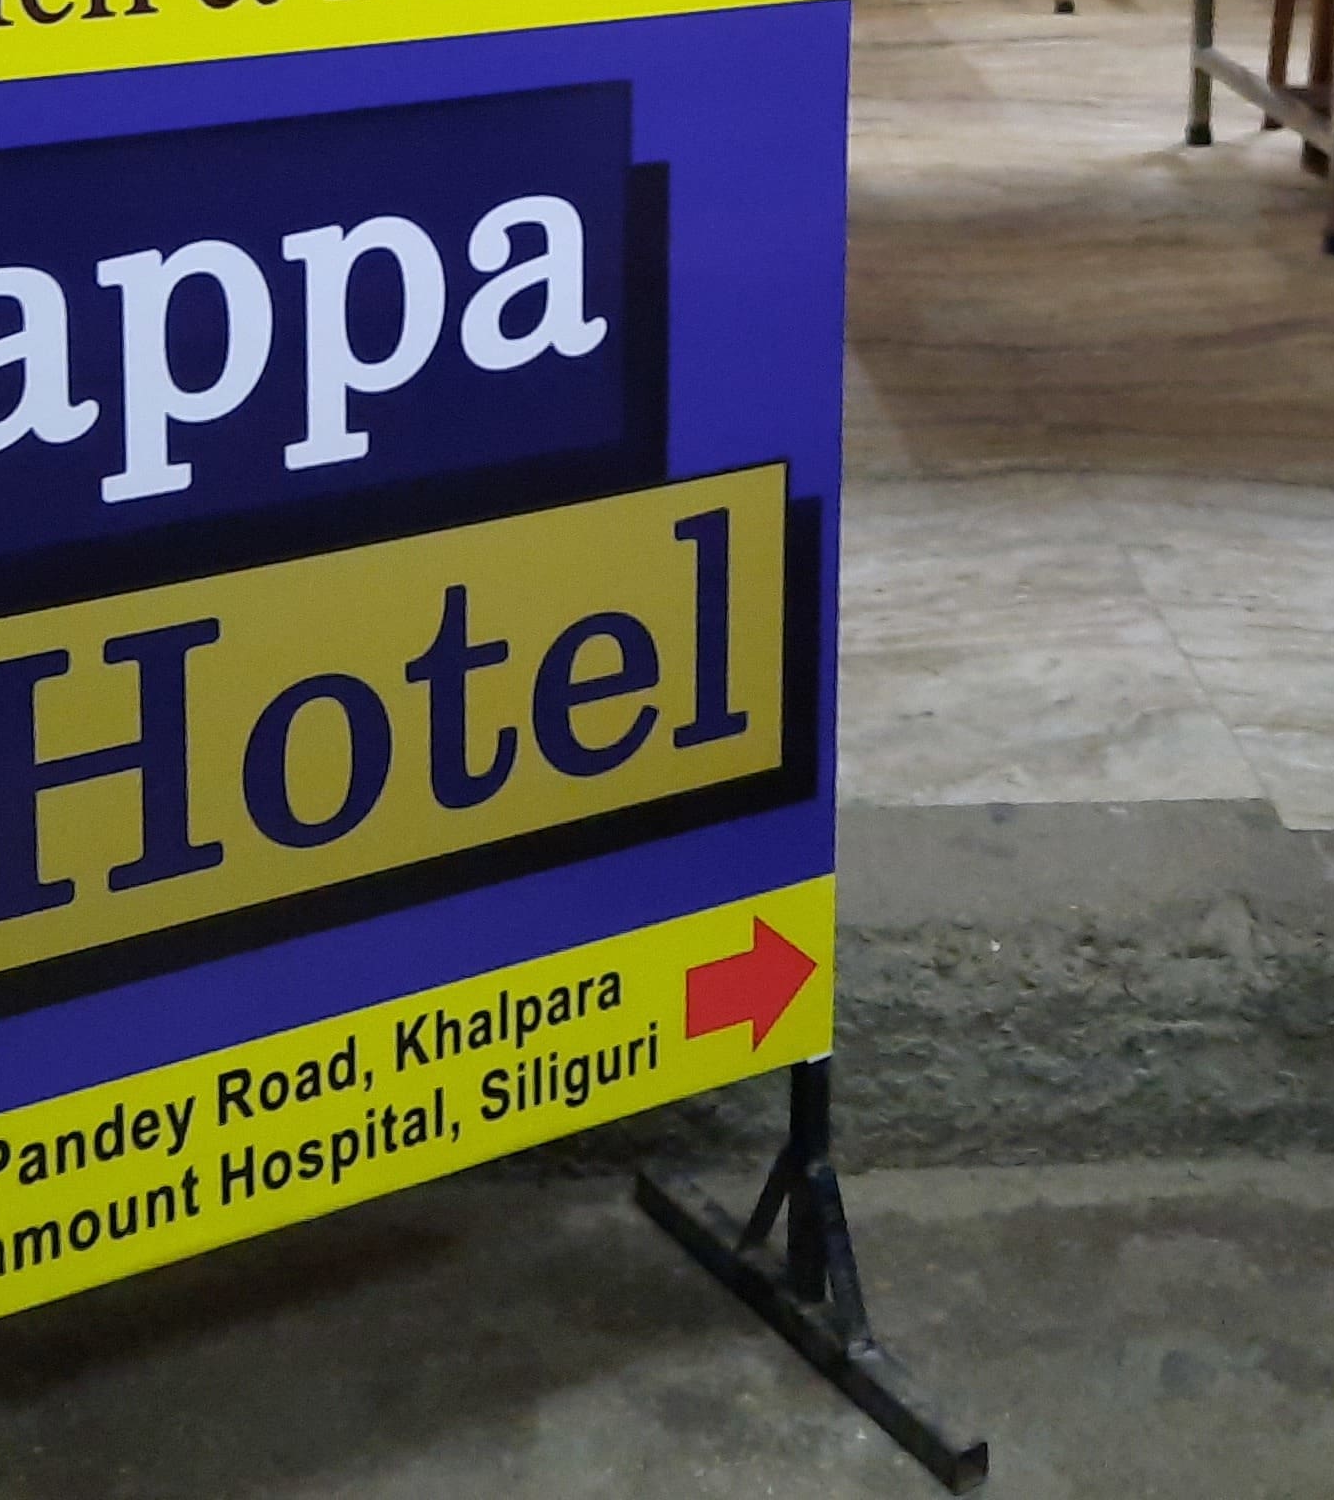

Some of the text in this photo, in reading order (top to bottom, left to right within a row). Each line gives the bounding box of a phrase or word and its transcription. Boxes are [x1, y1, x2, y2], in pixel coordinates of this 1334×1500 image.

[217, 1034, 375, 1127] Road,
[395, 970, 622, 1073] Khalpara
[220, 1086, 461, 1206] Hospital,
[480, 1020, 659, 1122] Siliguri
